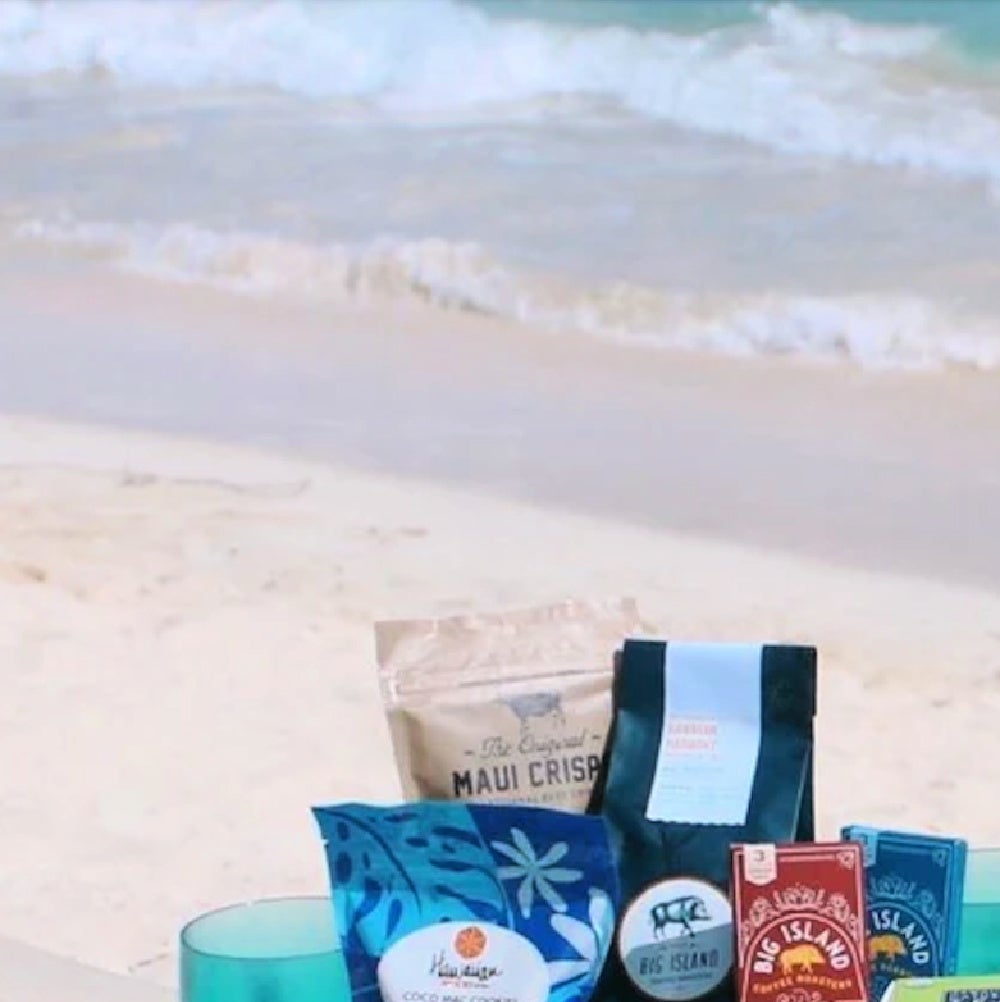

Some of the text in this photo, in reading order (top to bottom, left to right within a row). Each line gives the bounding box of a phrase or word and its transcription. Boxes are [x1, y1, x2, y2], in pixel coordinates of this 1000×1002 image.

[451, 762, 519, 798] MAUI
[753, 920, 851, 974] BIG ISLAND
[871, 908, 930, 965] ISLAND
